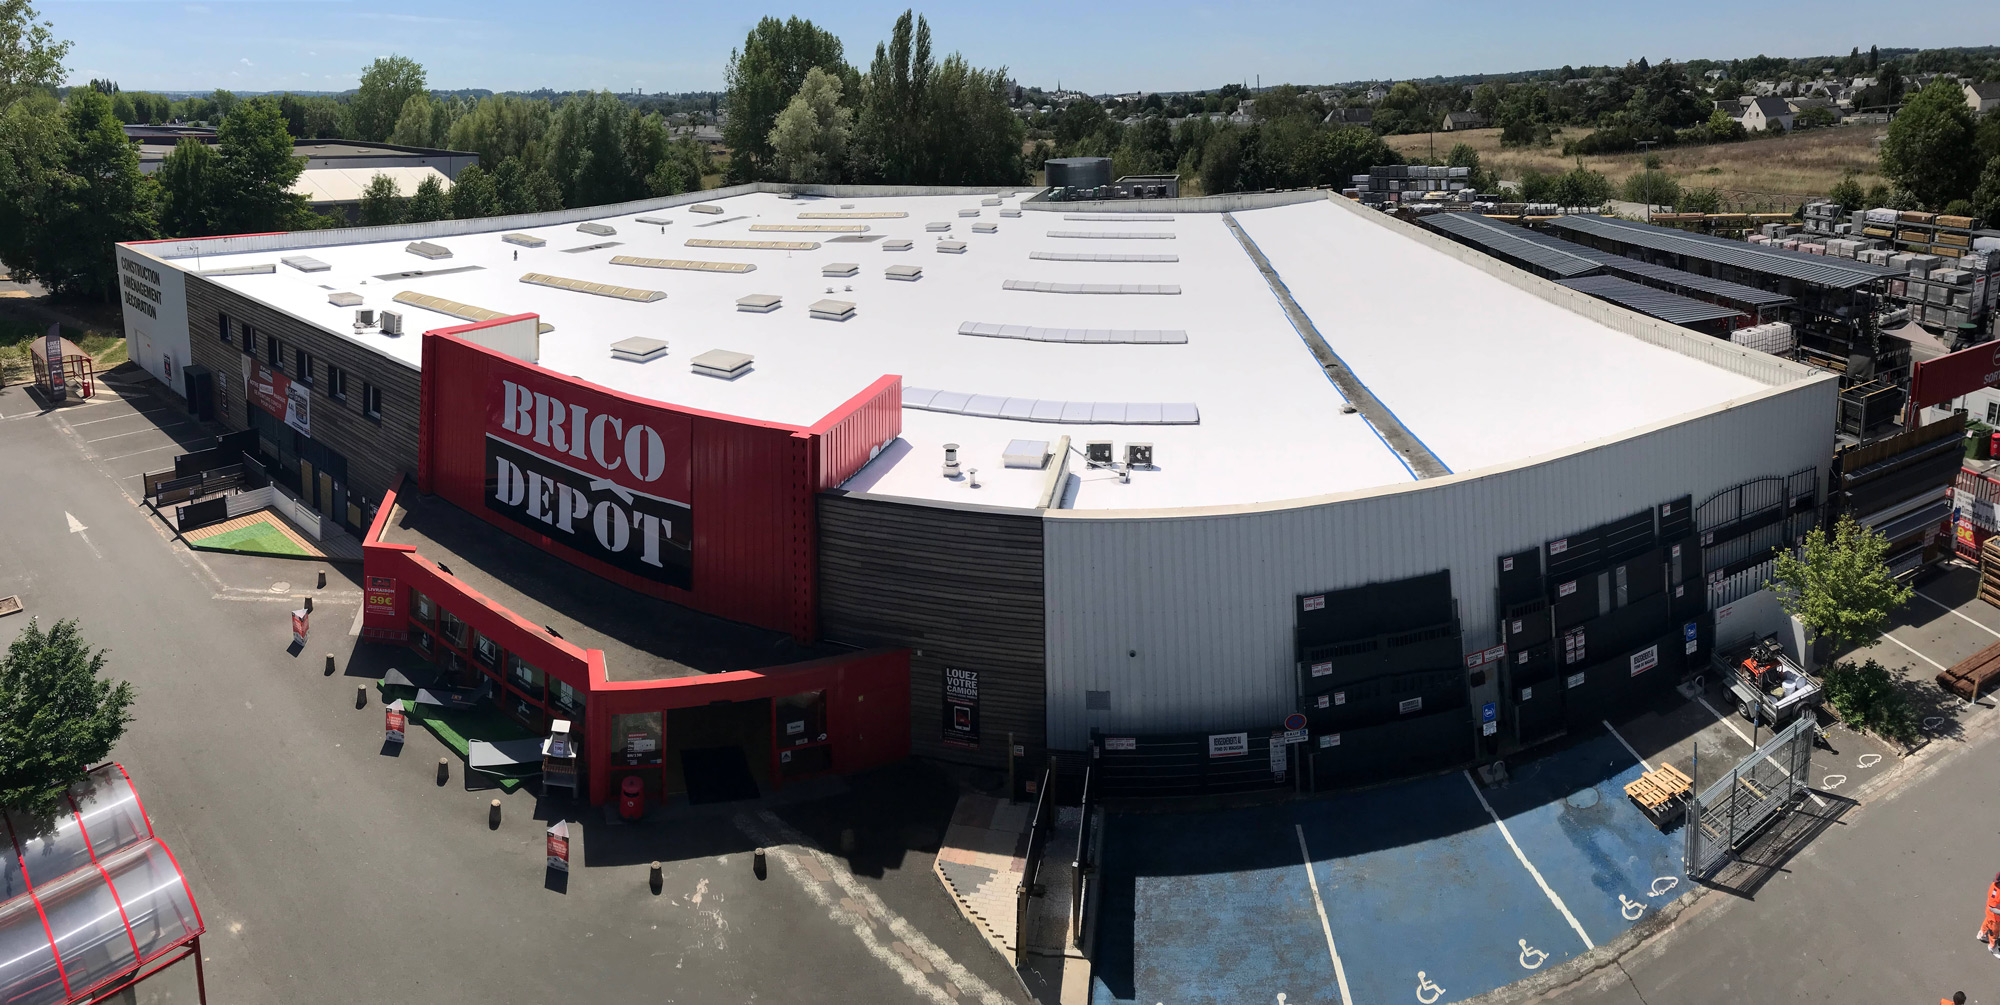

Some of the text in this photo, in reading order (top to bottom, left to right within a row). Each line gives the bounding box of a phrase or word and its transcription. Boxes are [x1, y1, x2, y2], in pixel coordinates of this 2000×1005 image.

[121, 256, 160, 286] CONSTRUCTION
[125, 291, 157, 320] DÉCORATION
[502, 380, 666, 482] BRICO
[369, 595, 393, 605] 59€
[946, 668, 978, 681] LOUEZ
[946, 677, 978, 689] VOTRE
[946, 685, 978, 696] CAMION
